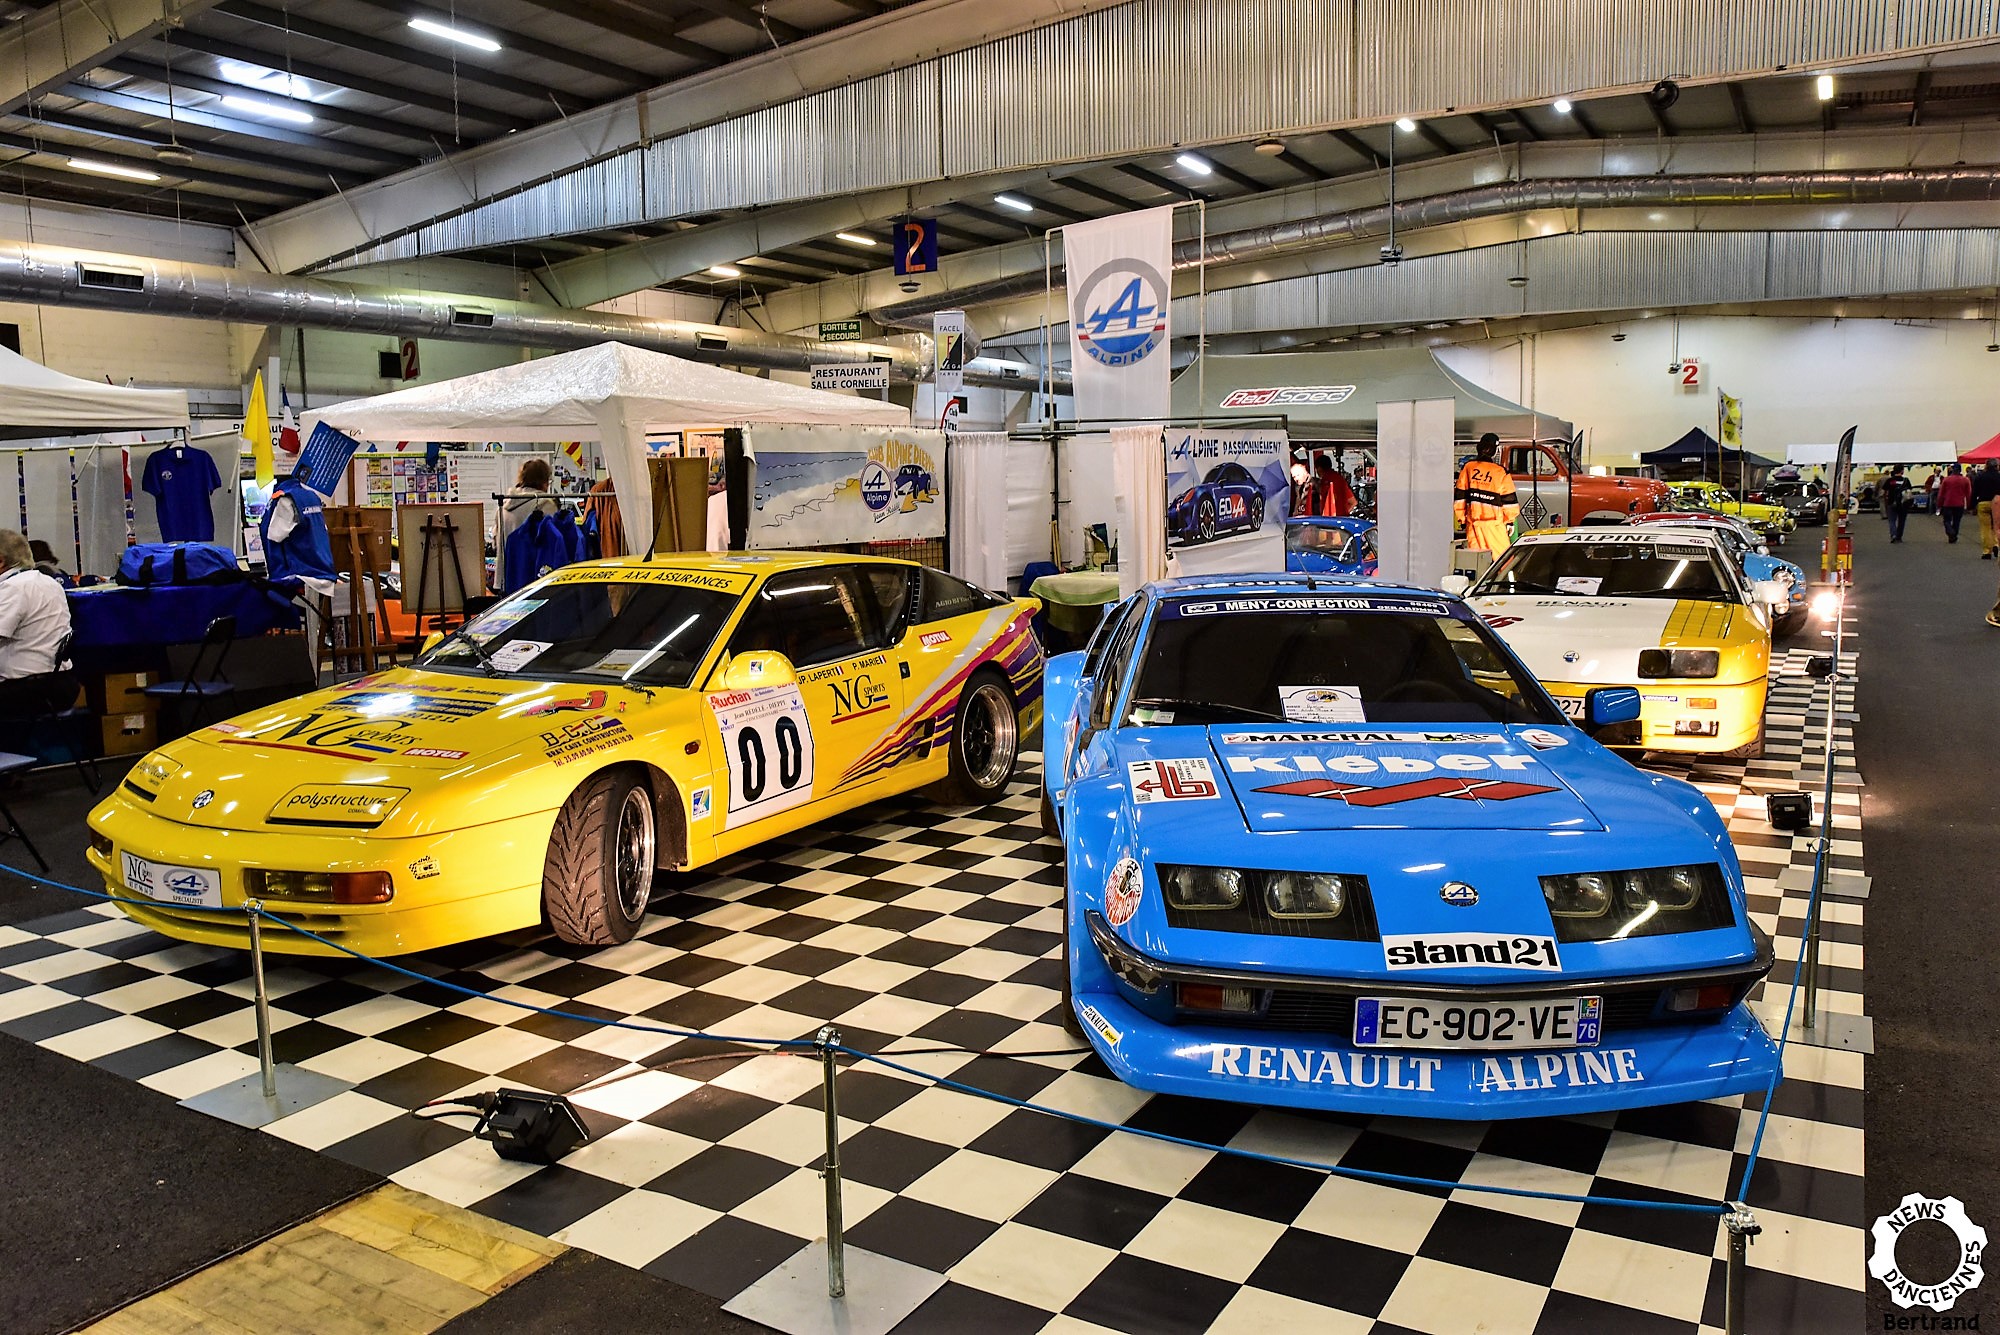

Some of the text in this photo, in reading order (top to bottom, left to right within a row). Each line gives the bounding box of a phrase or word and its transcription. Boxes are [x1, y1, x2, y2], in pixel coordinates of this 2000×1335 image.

[904, 223, 926, 273] 2
[822, 322, 857, 332] SORTIE de
[826, 332, 861, 341] SECOURS
[402, 340, 419, 380] 2
[1088, 338, 1155, 365] ALPINE
[815, 367, 882, 378] RESTAURANT
[1682, 365, 1698, 385] 2
[811, 378, 887, 389] SALLE CORNEILLE
[886, 440, 913, 469] ALPINE
[1222, 437, 1282, 455] PASSIONNÉMENT
[866, 492, 888, 505] Alpine
[1218, 496, 1231, 516] 60
[1563, 533, 1659, 543] ALPINE
[621, 570, 651, 581] AXA
[652, 571, 733, 589] ASSURANCES
[1225, 599, 1371, 612] MENY-CONFECTION
[1376, 605, 1441, 614] GERARDMER
[921, 631, 951, 646] MOTUL
[852, 656, 881, 671] P. MARIE
[827, 674, 875, 718] NG
[863, 683, 886, 696] SPORTS
[709, 691, 752, 710] Auchan
[252, 712, 414, 747] NG
[351, 729, 423, 746] SPORTS
[582, 726, 627, 745] CONSTRUCTION
[1248, 733, 1404, 742] MARCHAL
[406, 748, 467, 760] MOTUL
[287, 792, 388, 809] polystructure
[127, 855, 147, 882] NG
[1387, 937, 1559, 967] stand21
[1083, 1007, 1109, 1033] RENAULT
[1380, 1004, 1575, 1042] EC-902-VE
[1362, 1026, 1370, 1037] F
[1579, 1022, 1597, 1040] 76
[1207, 1043, 1645, 1093] RENAULT ALPINE
